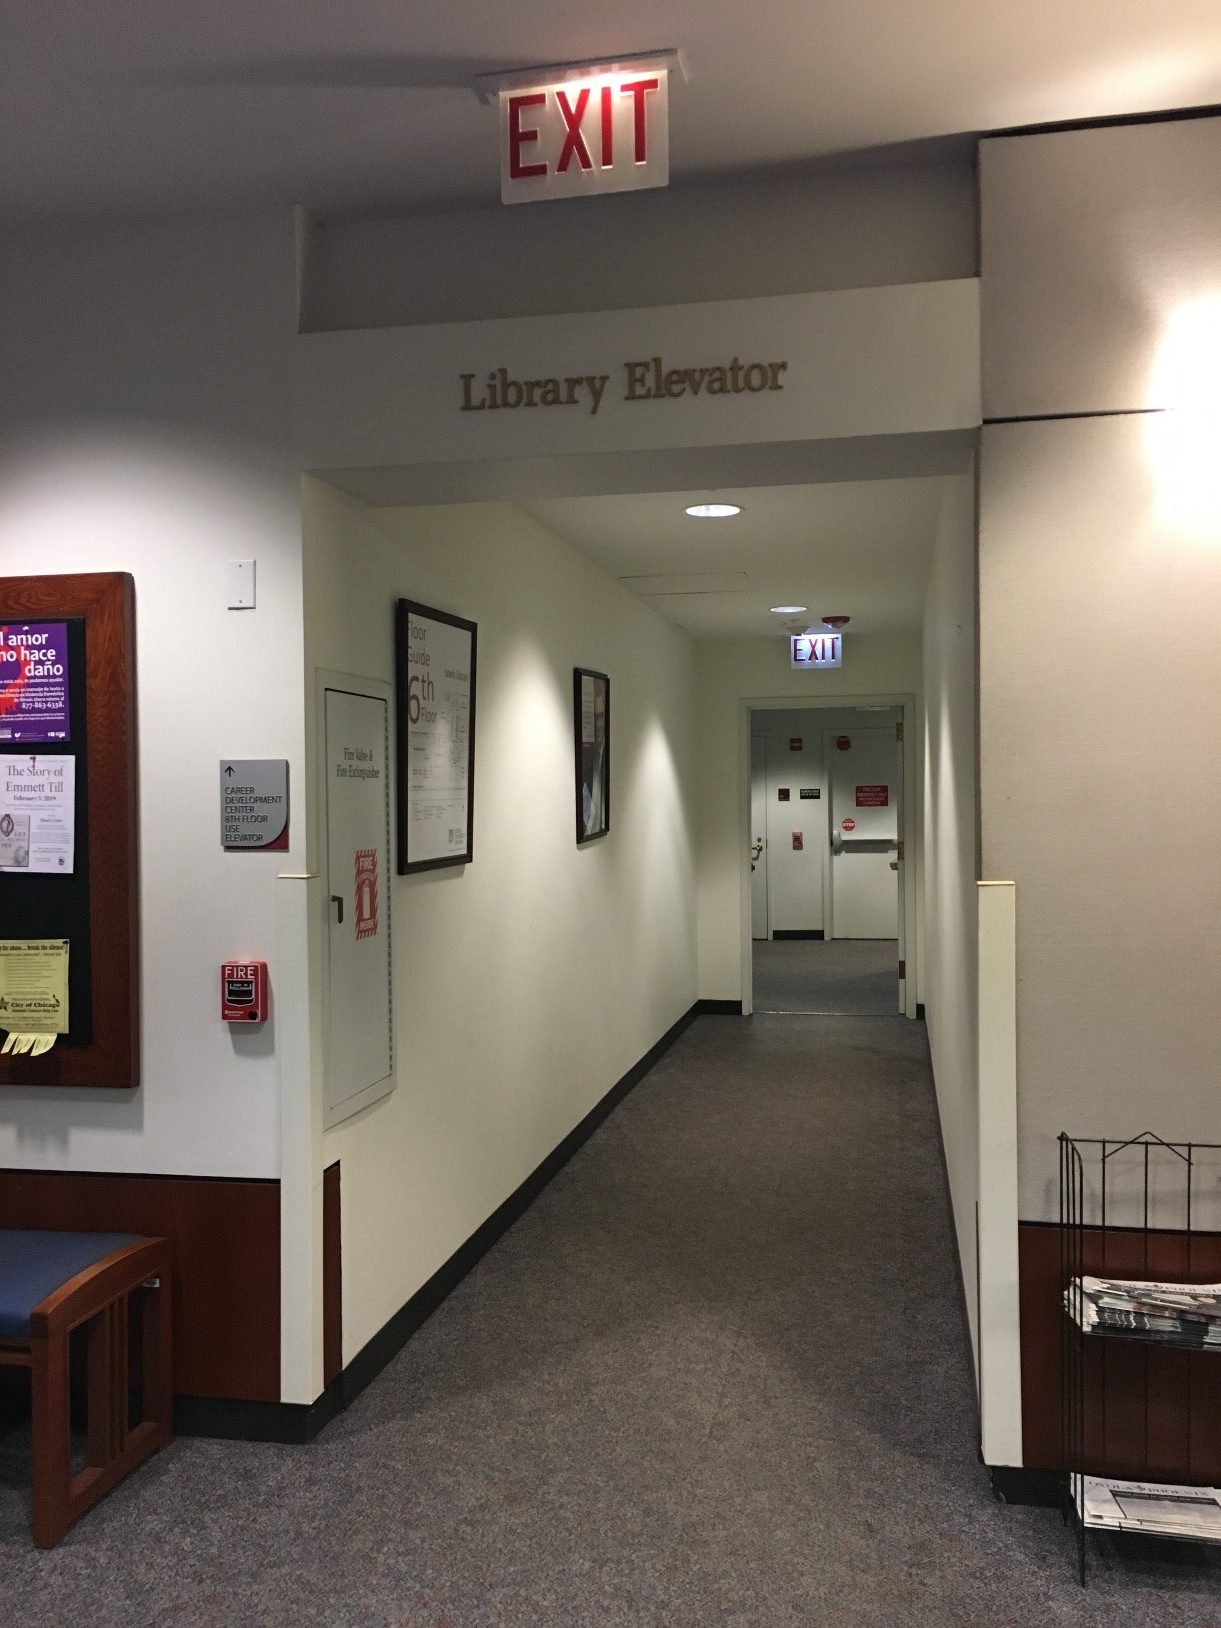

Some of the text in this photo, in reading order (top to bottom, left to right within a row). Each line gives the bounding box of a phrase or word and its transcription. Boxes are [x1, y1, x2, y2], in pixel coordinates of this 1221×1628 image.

[508, 78, 658, 180] EXIT
[459, 357, 788, 414] Library Elevator
[408, 620, 426, 641] loor
[8, 633, 49, 646] amor
[20, 646, 56, 661] hace
[794, 637, 839, 661] EXIT
[25, 661, 64, 676] daño
[408, 671, 435, 724] 6th
[421, 707, 438, 723] Floor
[6, 765, 64, 780] The Story of
[6, 781, 64, 793] Emmett Till
[225, 786, 255, 795] CAREER
[225, 795, 283, 805] DEVELOPMENT
[225, 805, 255, 814] CENTER
[242, 815, 268, 823] FLOOR
[225, 824, 241, 833] USE
[225, 833, 264, 842] ELEVATOR
[225, 966, 255, 979] FIRE
[34, 1001, 61, 1009] Chicago
